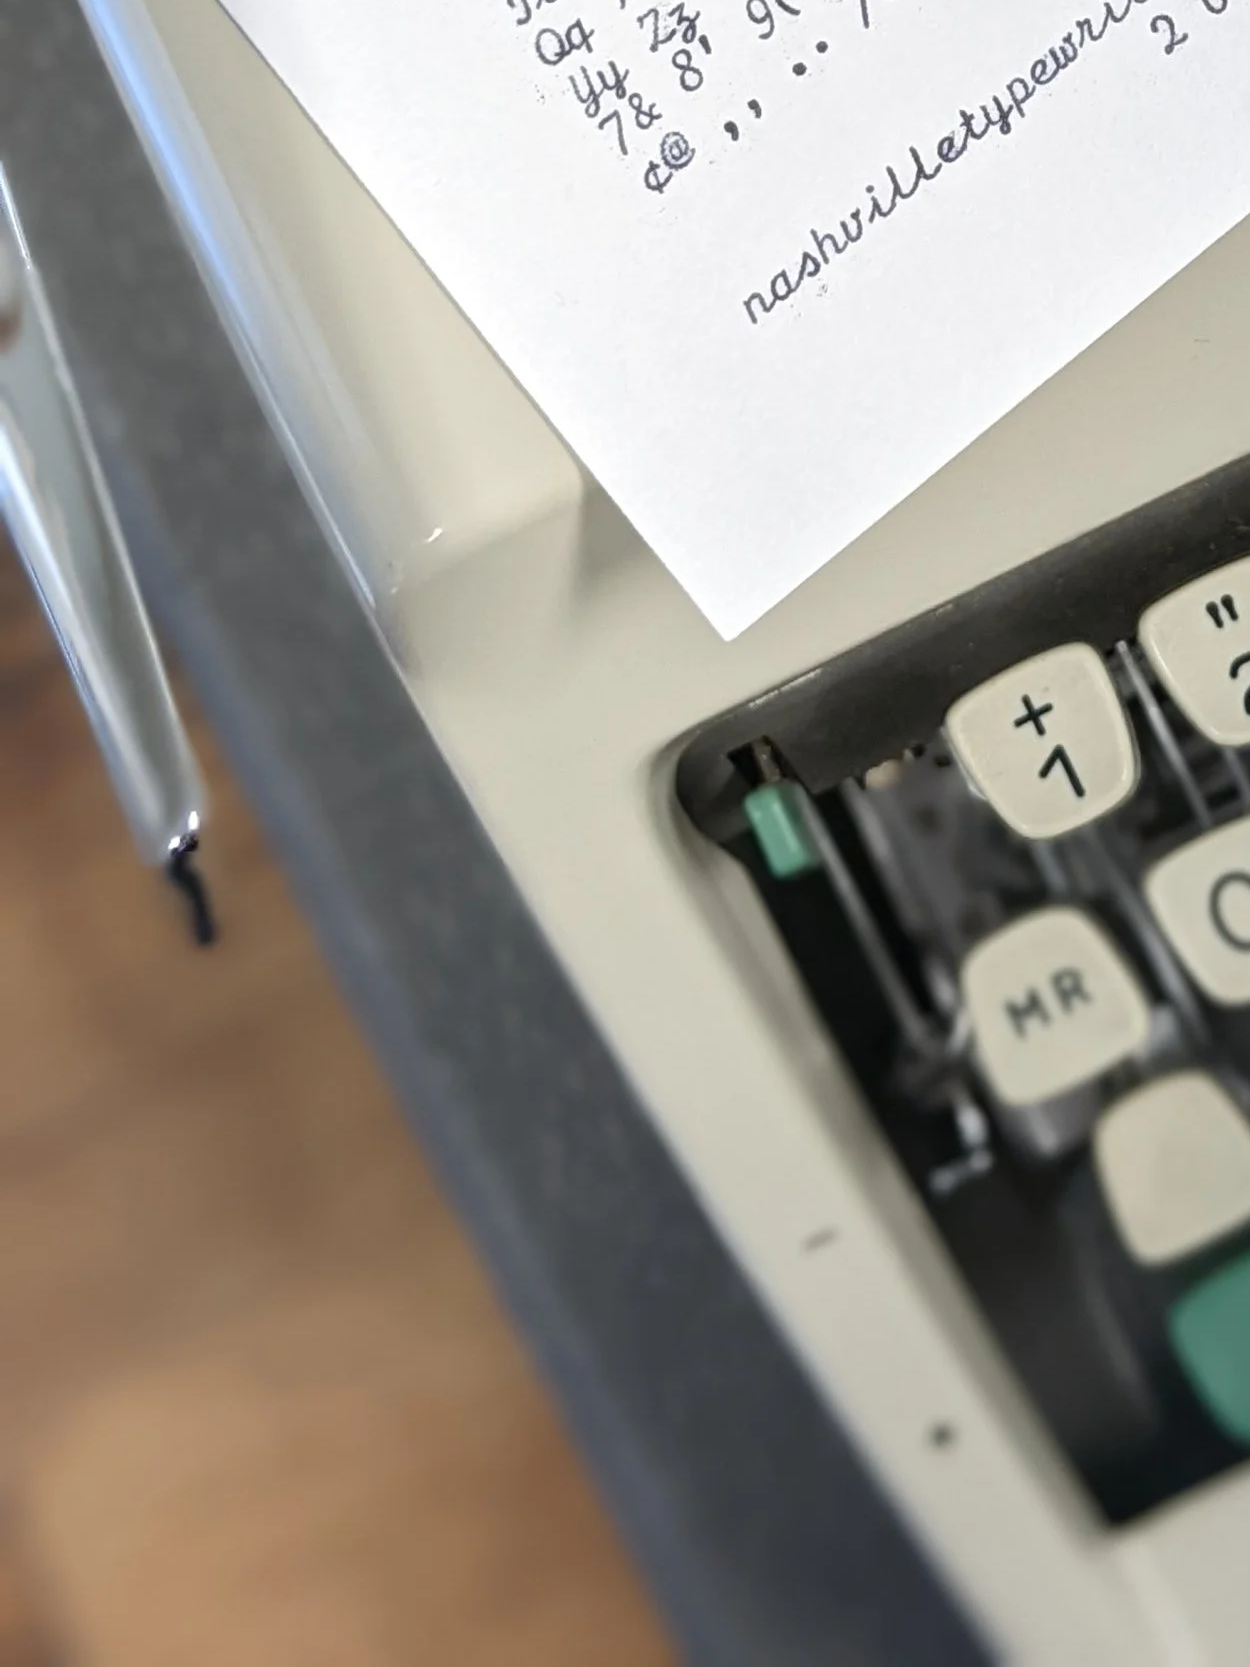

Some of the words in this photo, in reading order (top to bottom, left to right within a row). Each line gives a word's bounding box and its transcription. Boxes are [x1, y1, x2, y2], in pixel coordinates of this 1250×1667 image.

[534, 18, 595, 66] Qq
[568, 60, 630, 118] Yy
[636, 1, 701, 53] Zz
[599, 93, 662, 156] 7&
[1038, 744, 1087, 798] 1
[1004, 967, 1092, 1039] MR
